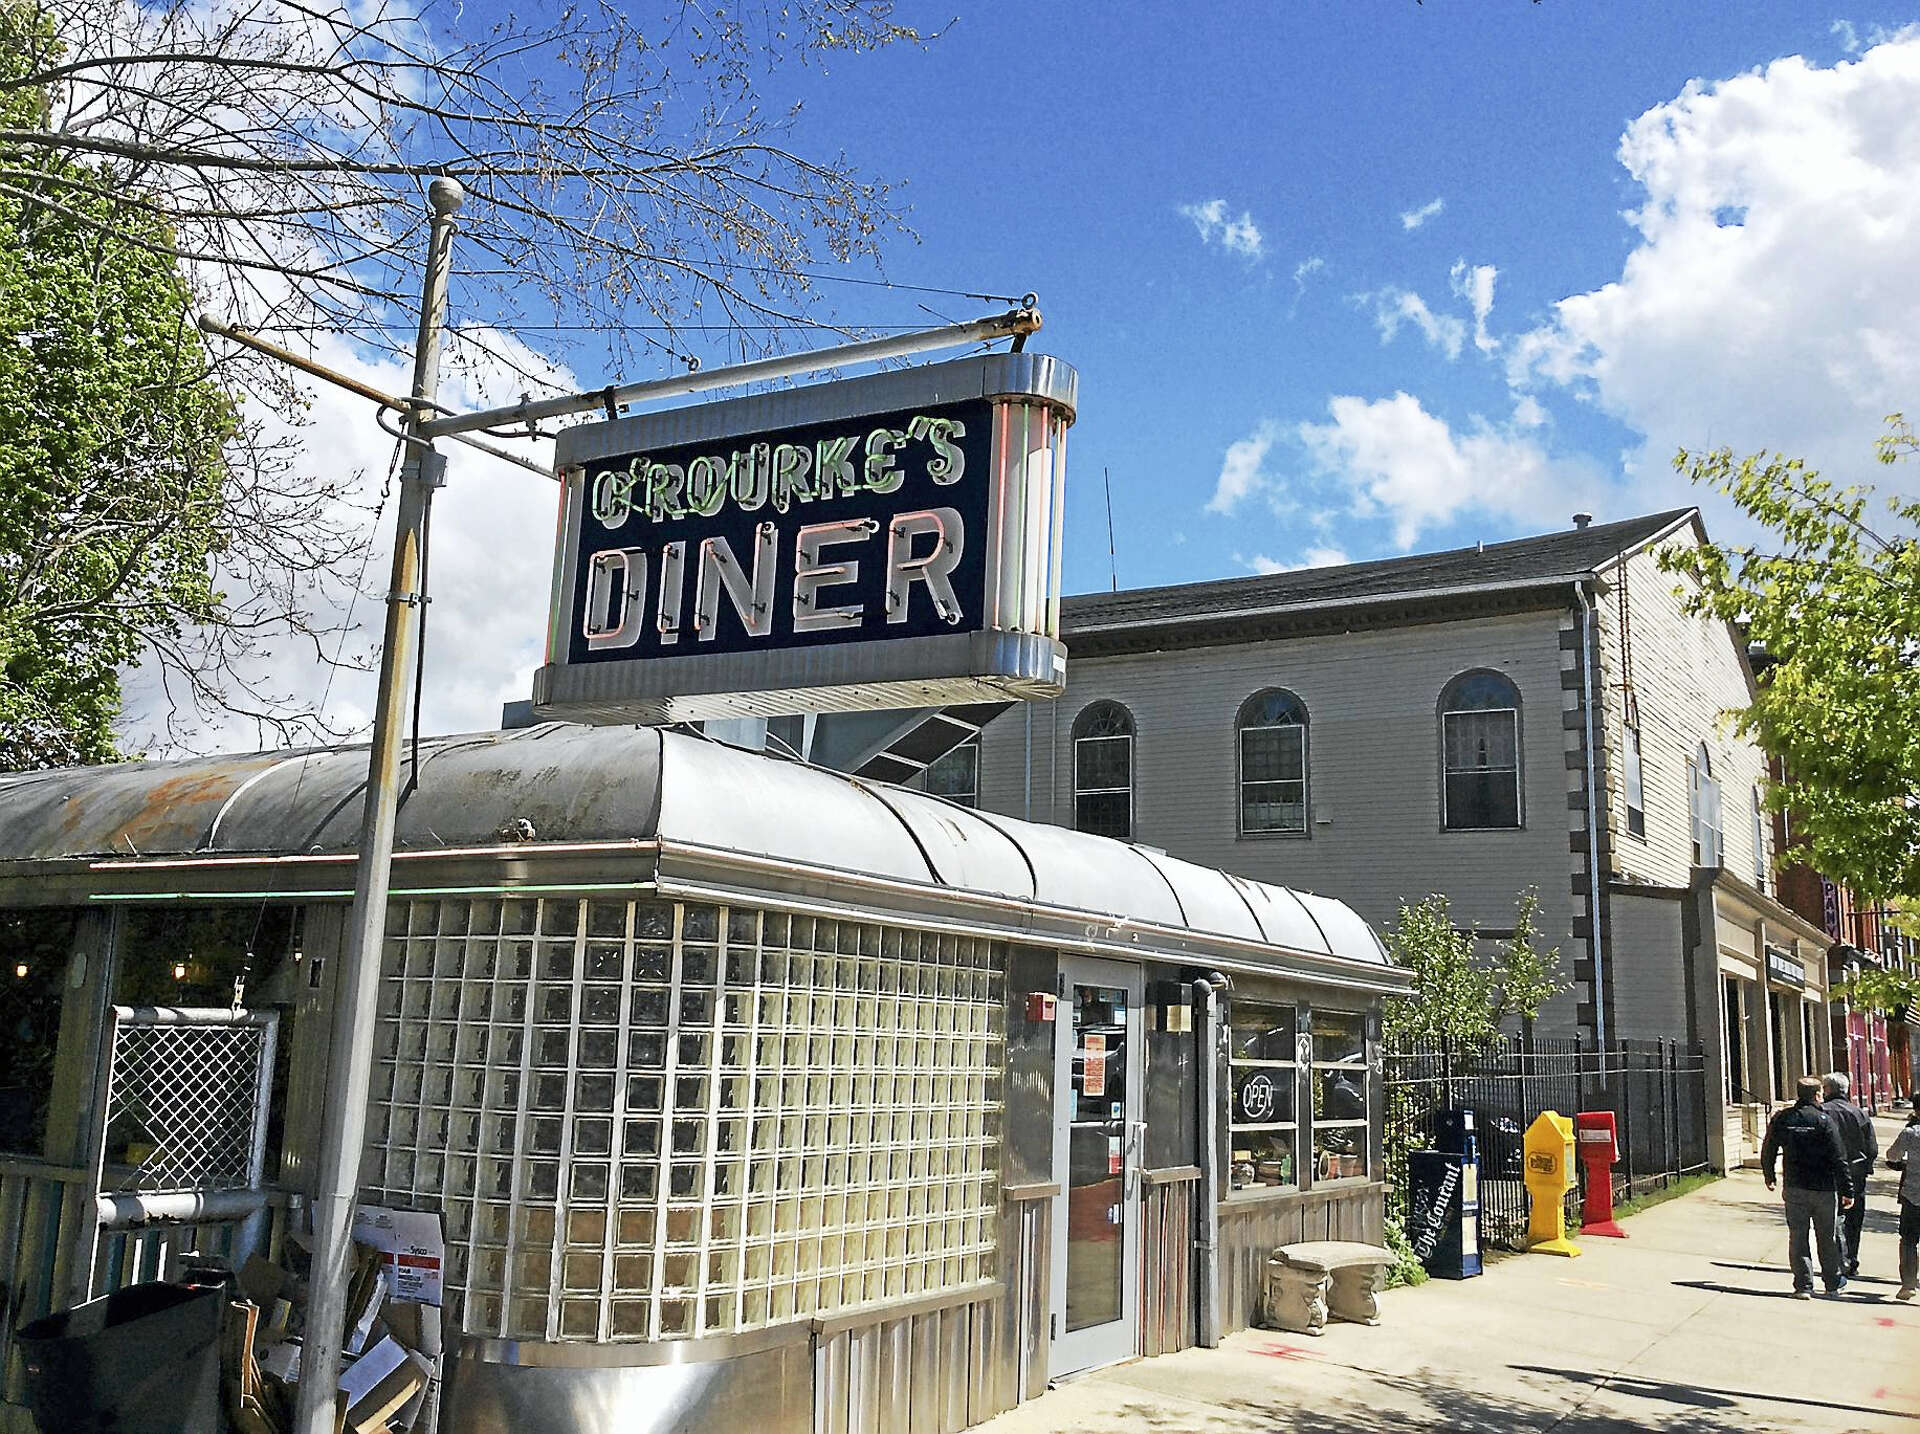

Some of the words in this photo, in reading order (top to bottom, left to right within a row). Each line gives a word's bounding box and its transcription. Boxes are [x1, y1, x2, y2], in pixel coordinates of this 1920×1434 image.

[592, 415, 966, 529] O'ROURKE'S
[583, 507, 964, 651] DINER
[1823, 877, 1838, 940] PANY
[1243, 1083, 1273, 1108] OPEN
[410, 1245, 428, 1256] Sysco
[1414, 1228, 1437, 1259] The
[1426, 1162, 1461, 1230] Courant
